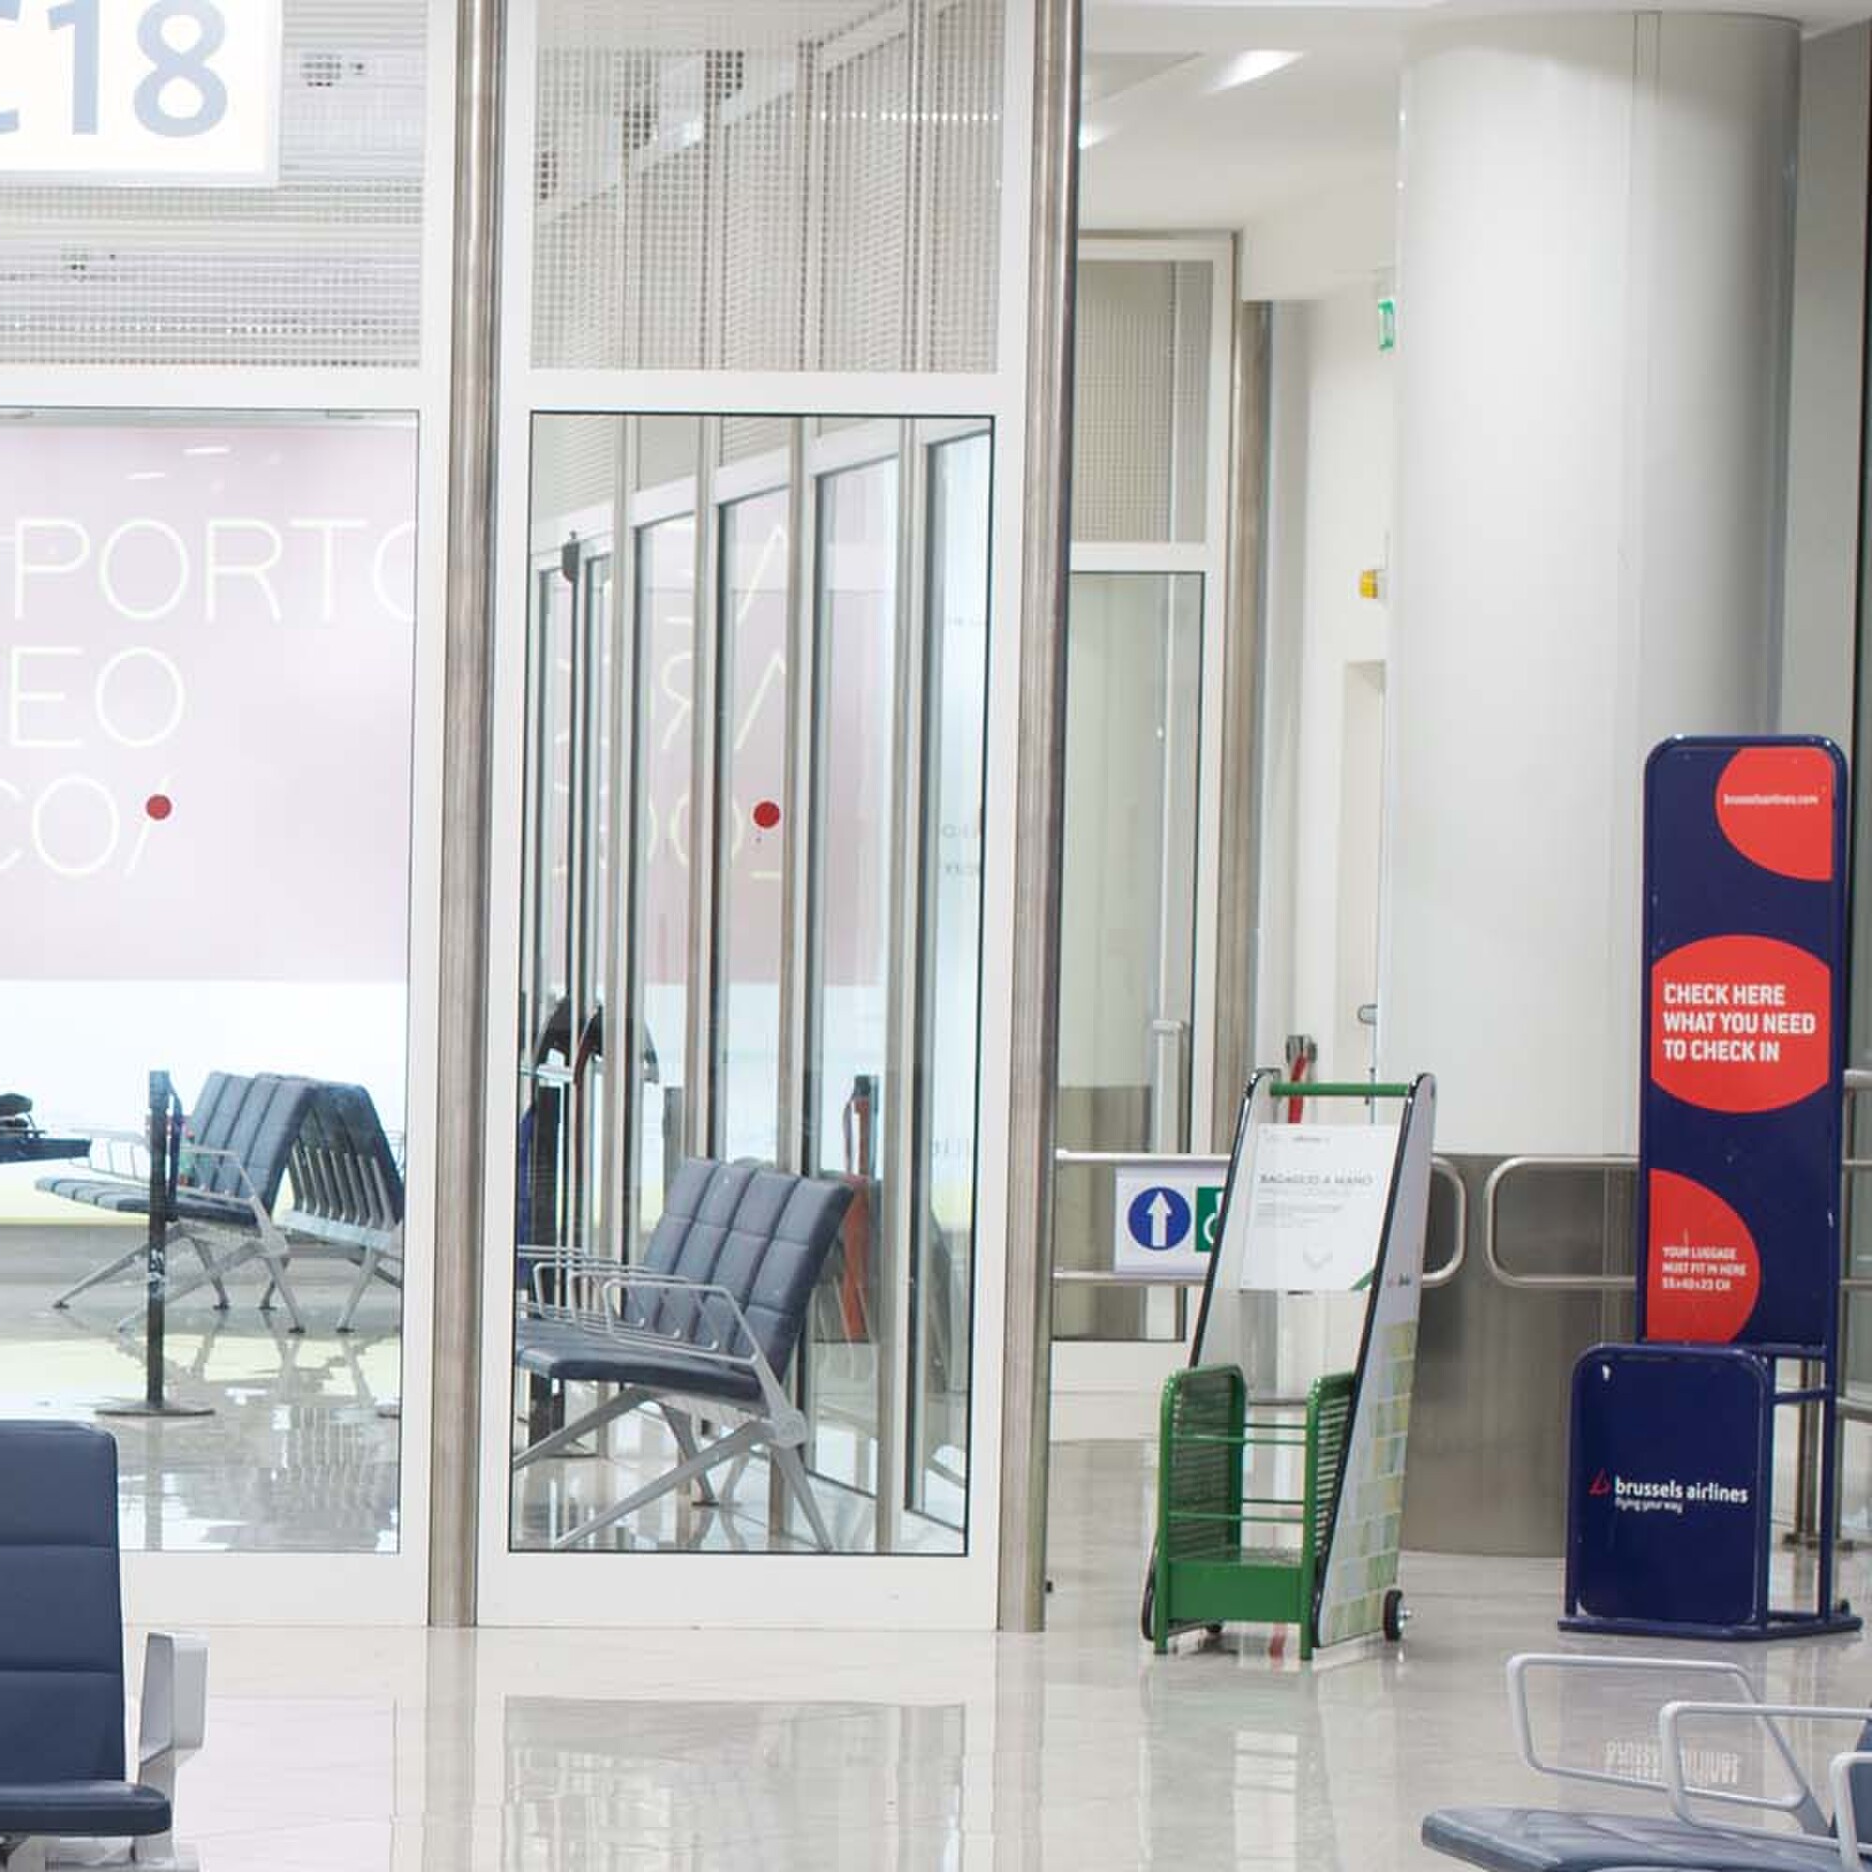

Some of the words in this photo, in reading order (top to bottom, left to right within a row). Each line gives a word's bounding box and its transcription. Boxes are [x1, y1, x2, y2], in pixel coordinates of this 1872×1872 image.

[1663, 982, 1728, 1006] CHECK
[1732, 984, 1786, 1007] HERE
[1662, 1010, 1716, 1034] WHAT
[1720, 1011, 1759, 1034] YOU
[1762, 1012, 1817, 1036] NEED
[1662, 1038, 1687, 1062] TO
[1690, 1039, 1756, 1062] CHECK
[1759, 1040, 1780, 1063] IN
[1614, 1475, 1684, 1499] brussels
[1685, 1481, 1749, 1504] airlines
